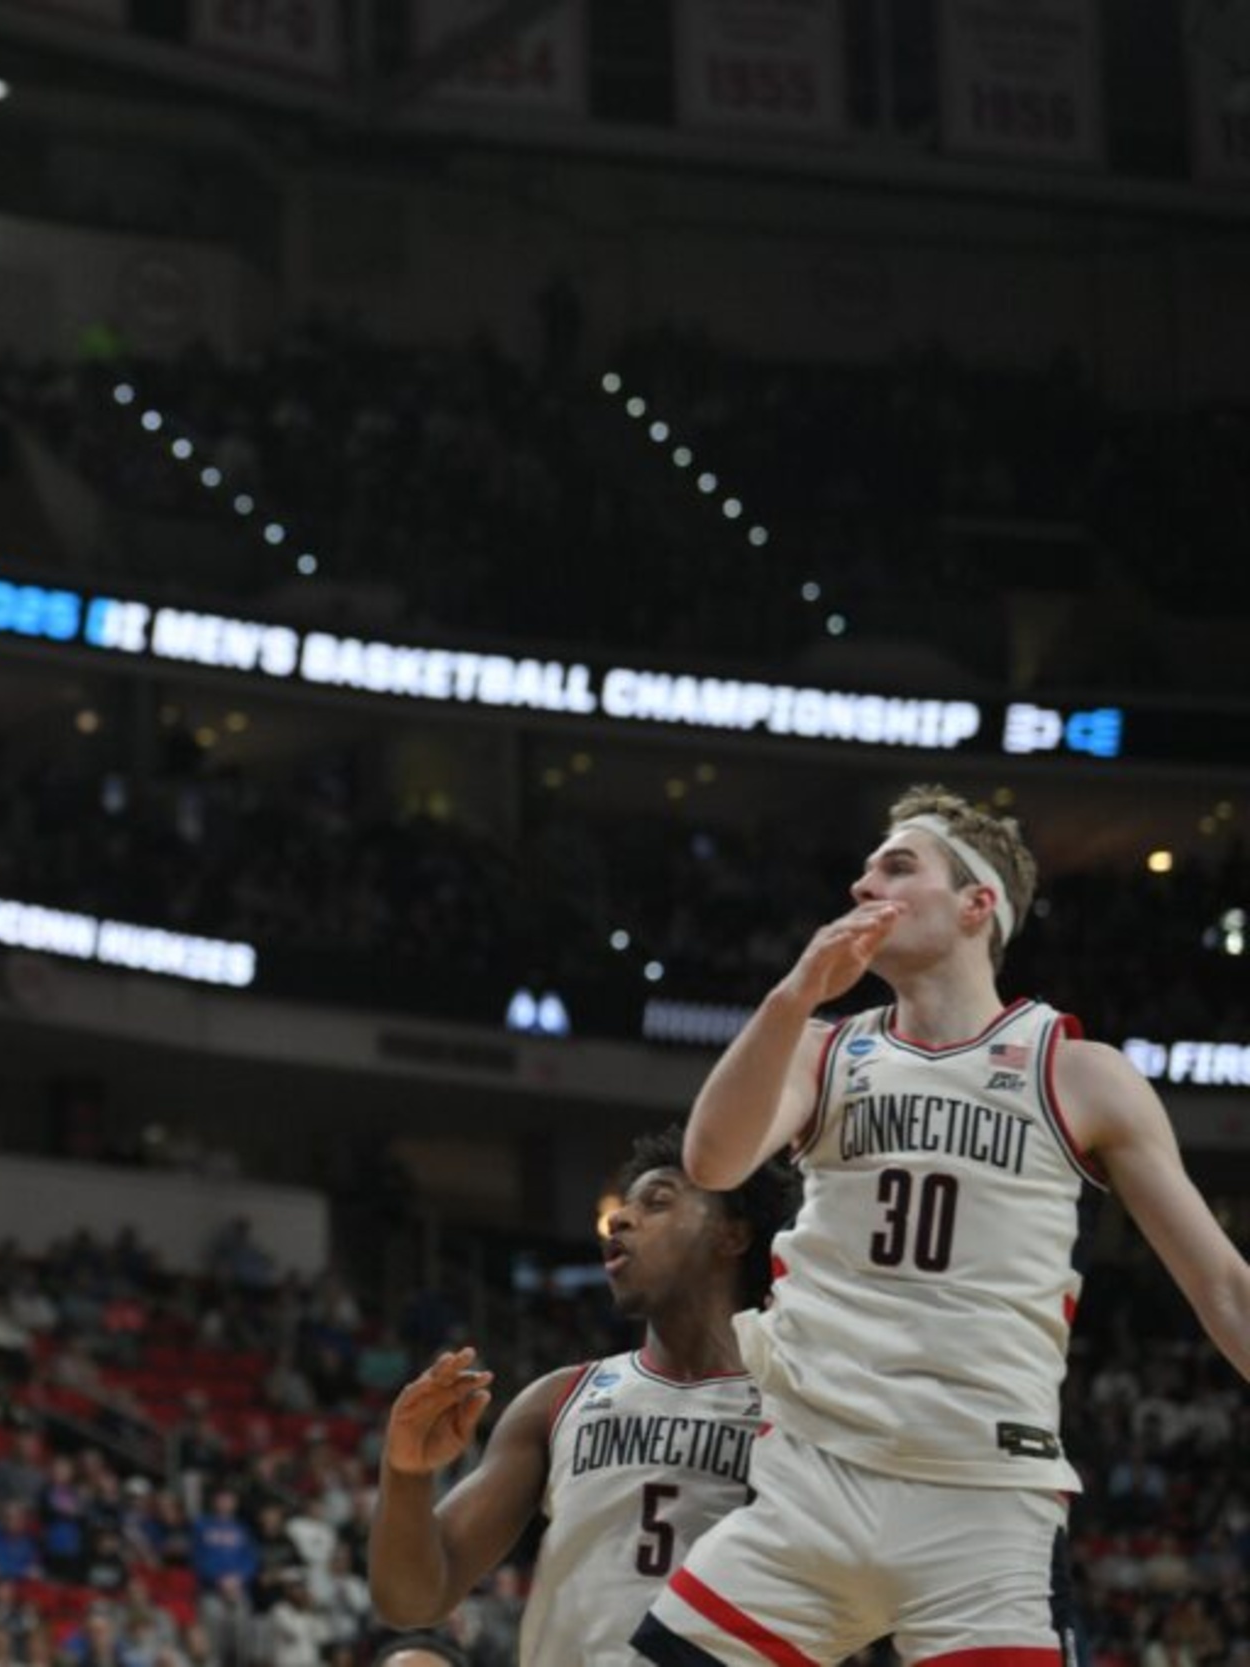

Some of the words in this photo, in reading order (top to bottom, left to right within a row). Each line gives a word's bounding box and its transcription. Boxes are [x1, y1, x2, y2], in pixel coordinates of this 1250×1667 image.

[153, 608, 297, 675] MEN'S
[302, 634, 594, 712] BASKETBALL
[603, 669, 977, 747] CHAMPIONSHIP
[840, 1093, 1034, 1175] CONNECTICUT
[870, 1168, 958, 1272] 30
[572, 1415, 755, 1486] CONNECTICU
[637, 1482, 679, 1577] 5
